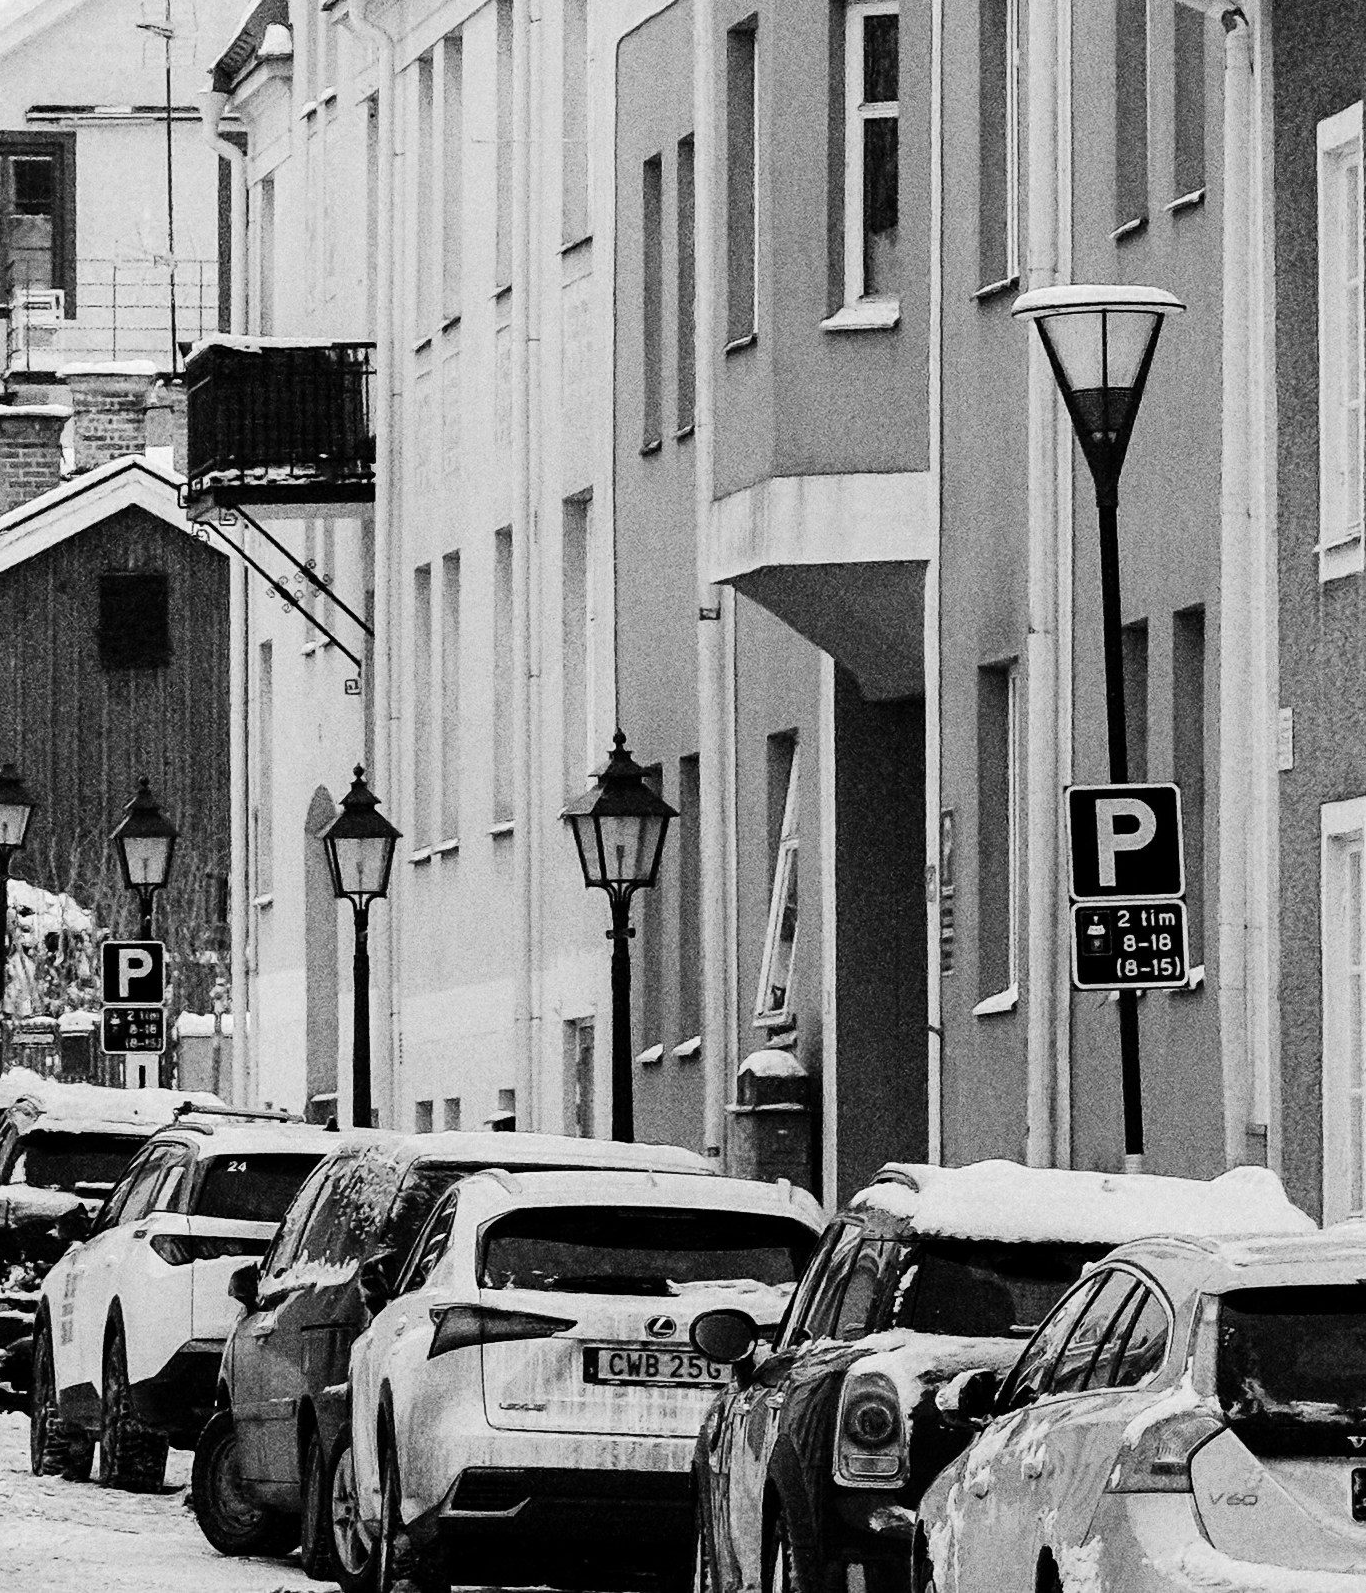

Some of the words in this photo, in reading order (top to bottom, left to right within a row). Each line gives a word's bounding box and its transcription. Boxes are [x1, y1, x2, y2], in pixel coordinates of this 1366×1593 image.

[1094, 798, 1157, 887] P
[1117, 910, 1131, 927] 2
[1141, 909, 1176, 927] tim
[1123, 933, 1172, 952] 8-18
[118, 948, 153, 997] P
[1116, 956, 1181, 978] (8-15)
[127, 1010, 135, 1021] 2
[227, 1160, 247, 1172] 24
[609, 1352, 660, 1378] CWB
[1209, 1492, 1258, 1506] V60
